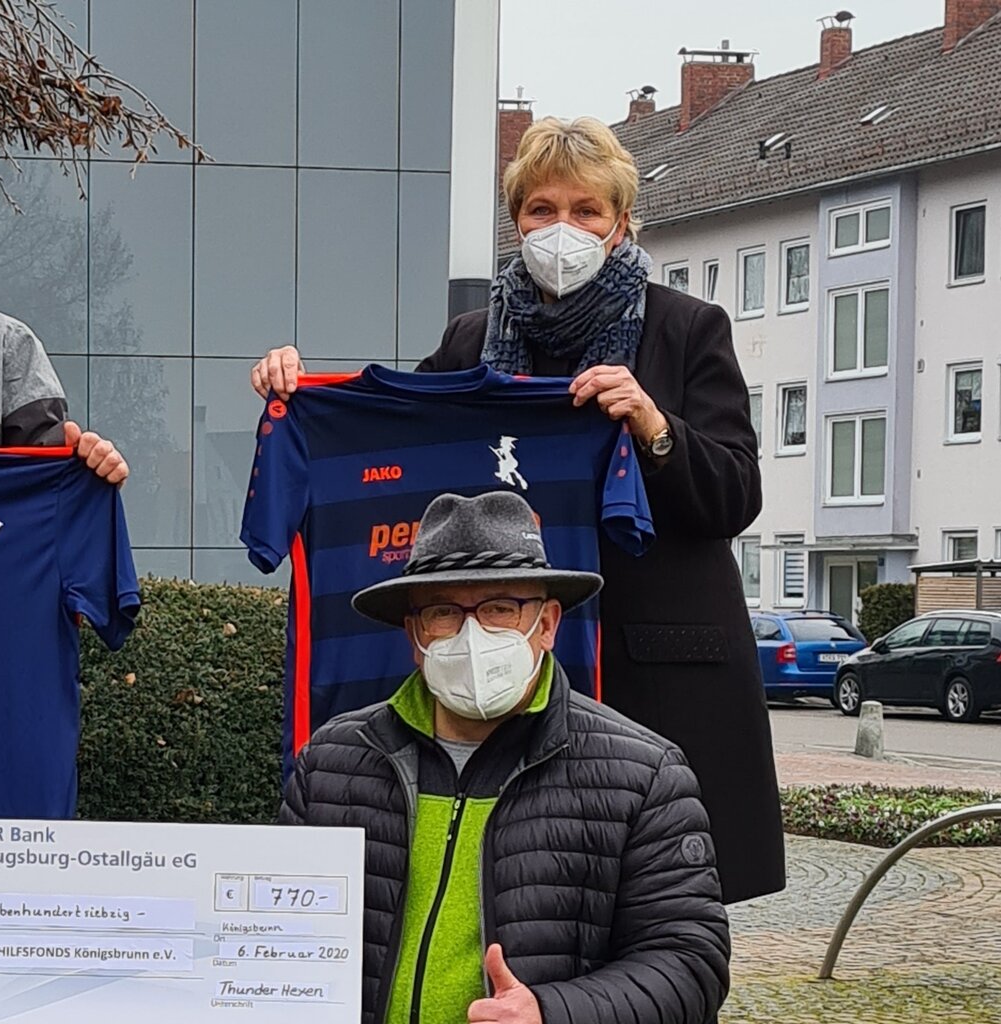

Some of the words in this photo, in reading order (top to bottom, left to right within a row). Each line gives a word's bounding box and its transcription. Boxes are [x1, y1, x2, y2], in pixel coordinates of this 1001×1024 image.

[362, 466, 402, 482] JAKO
[10, 826, 56, 843] Bank
[172, 852, 197, 868] eG
[226, 889, 234, 899] €
[74, 947, 150, 961] Königsbrunn
[153, 949, 177, 960] e.V.
[237, 945, 249, 958] 6.
[254, 945, 315, 958] Februar
[318, 946, 349, 960] 2020
[219, 980, 278, 996] Thunder
[281, 983, 324, 997] Hexen
